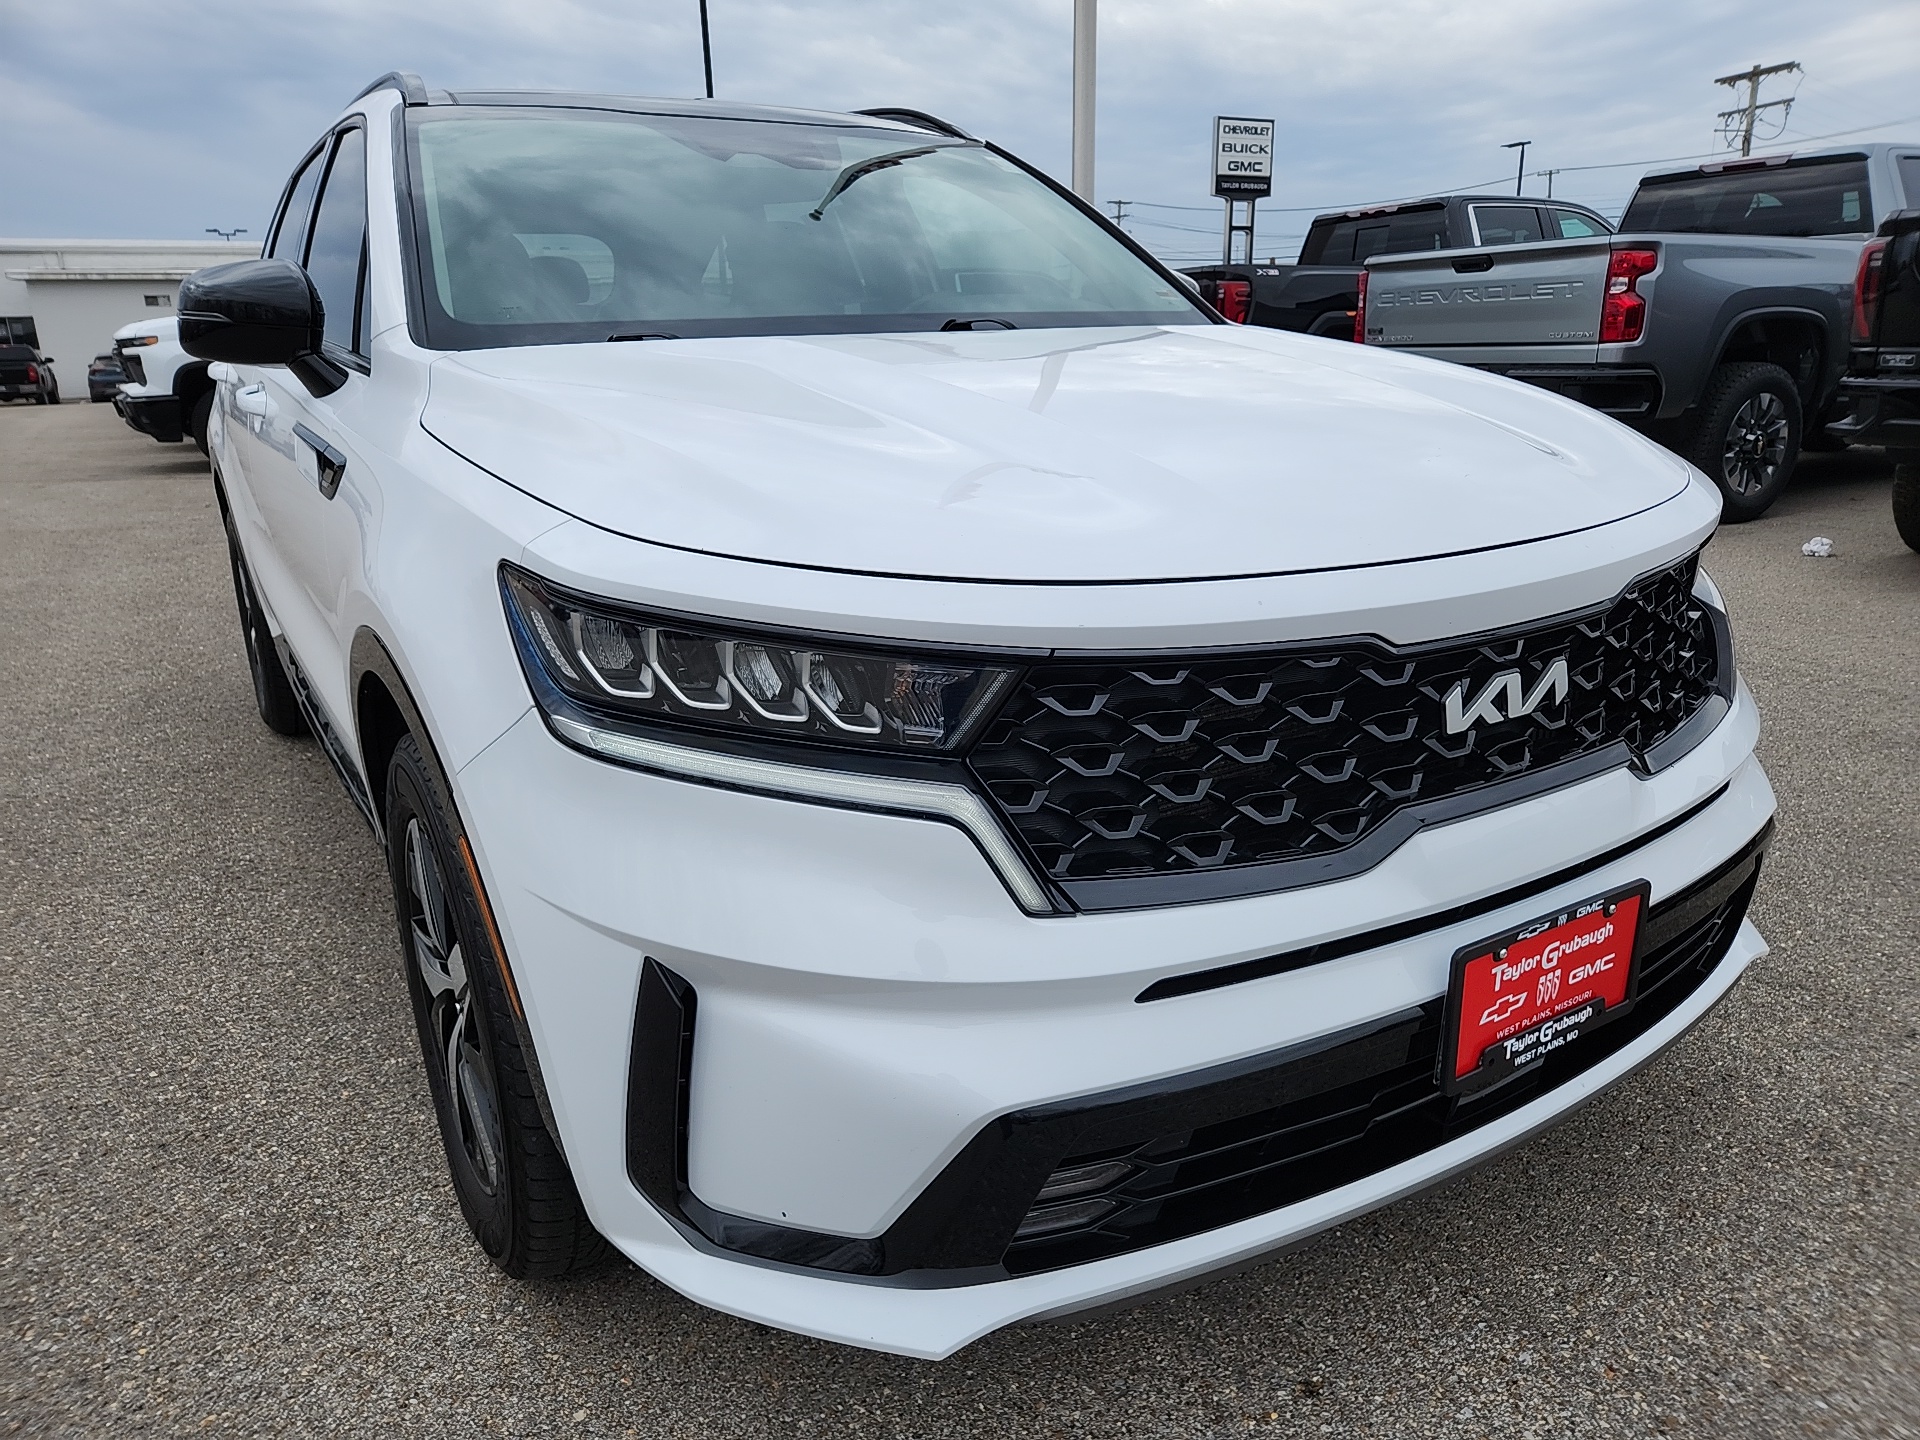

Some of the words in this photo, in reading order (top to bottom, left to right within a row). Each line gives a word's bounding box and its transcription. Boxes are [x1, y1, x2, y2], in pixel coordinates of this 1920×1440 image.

[1223, 125, 1271, 136] CHEVROLET
[1222, 143, 1270, 154] BUICK
[1228, 160, 1263, 172] GMC
[1377, 280, 1584, 307] CHEVROLET
[1576, 899, 1605, 918] GMC
[1491, 955, 1540, 992] Taylor
[1541, 922, 1614, 970] Grubaugh
[1568, 953, 1616, 985] GMC
[1496, 1022, 1520, 1039] WEST
[1522, 1008, 1552, 1028] PLAINS,
[1554, 990, 1592, 1012] MISSOURI
[1503, 1031, 1539, 1060] Taylor
[1539, 1006, 1593, 1043] Grubaugh
[1514, 1048, 1537, 1067] WEST
[1537, 1036, 1565, 1057] PLAINS,
[1566, 1029, 1579, 1043] MO
